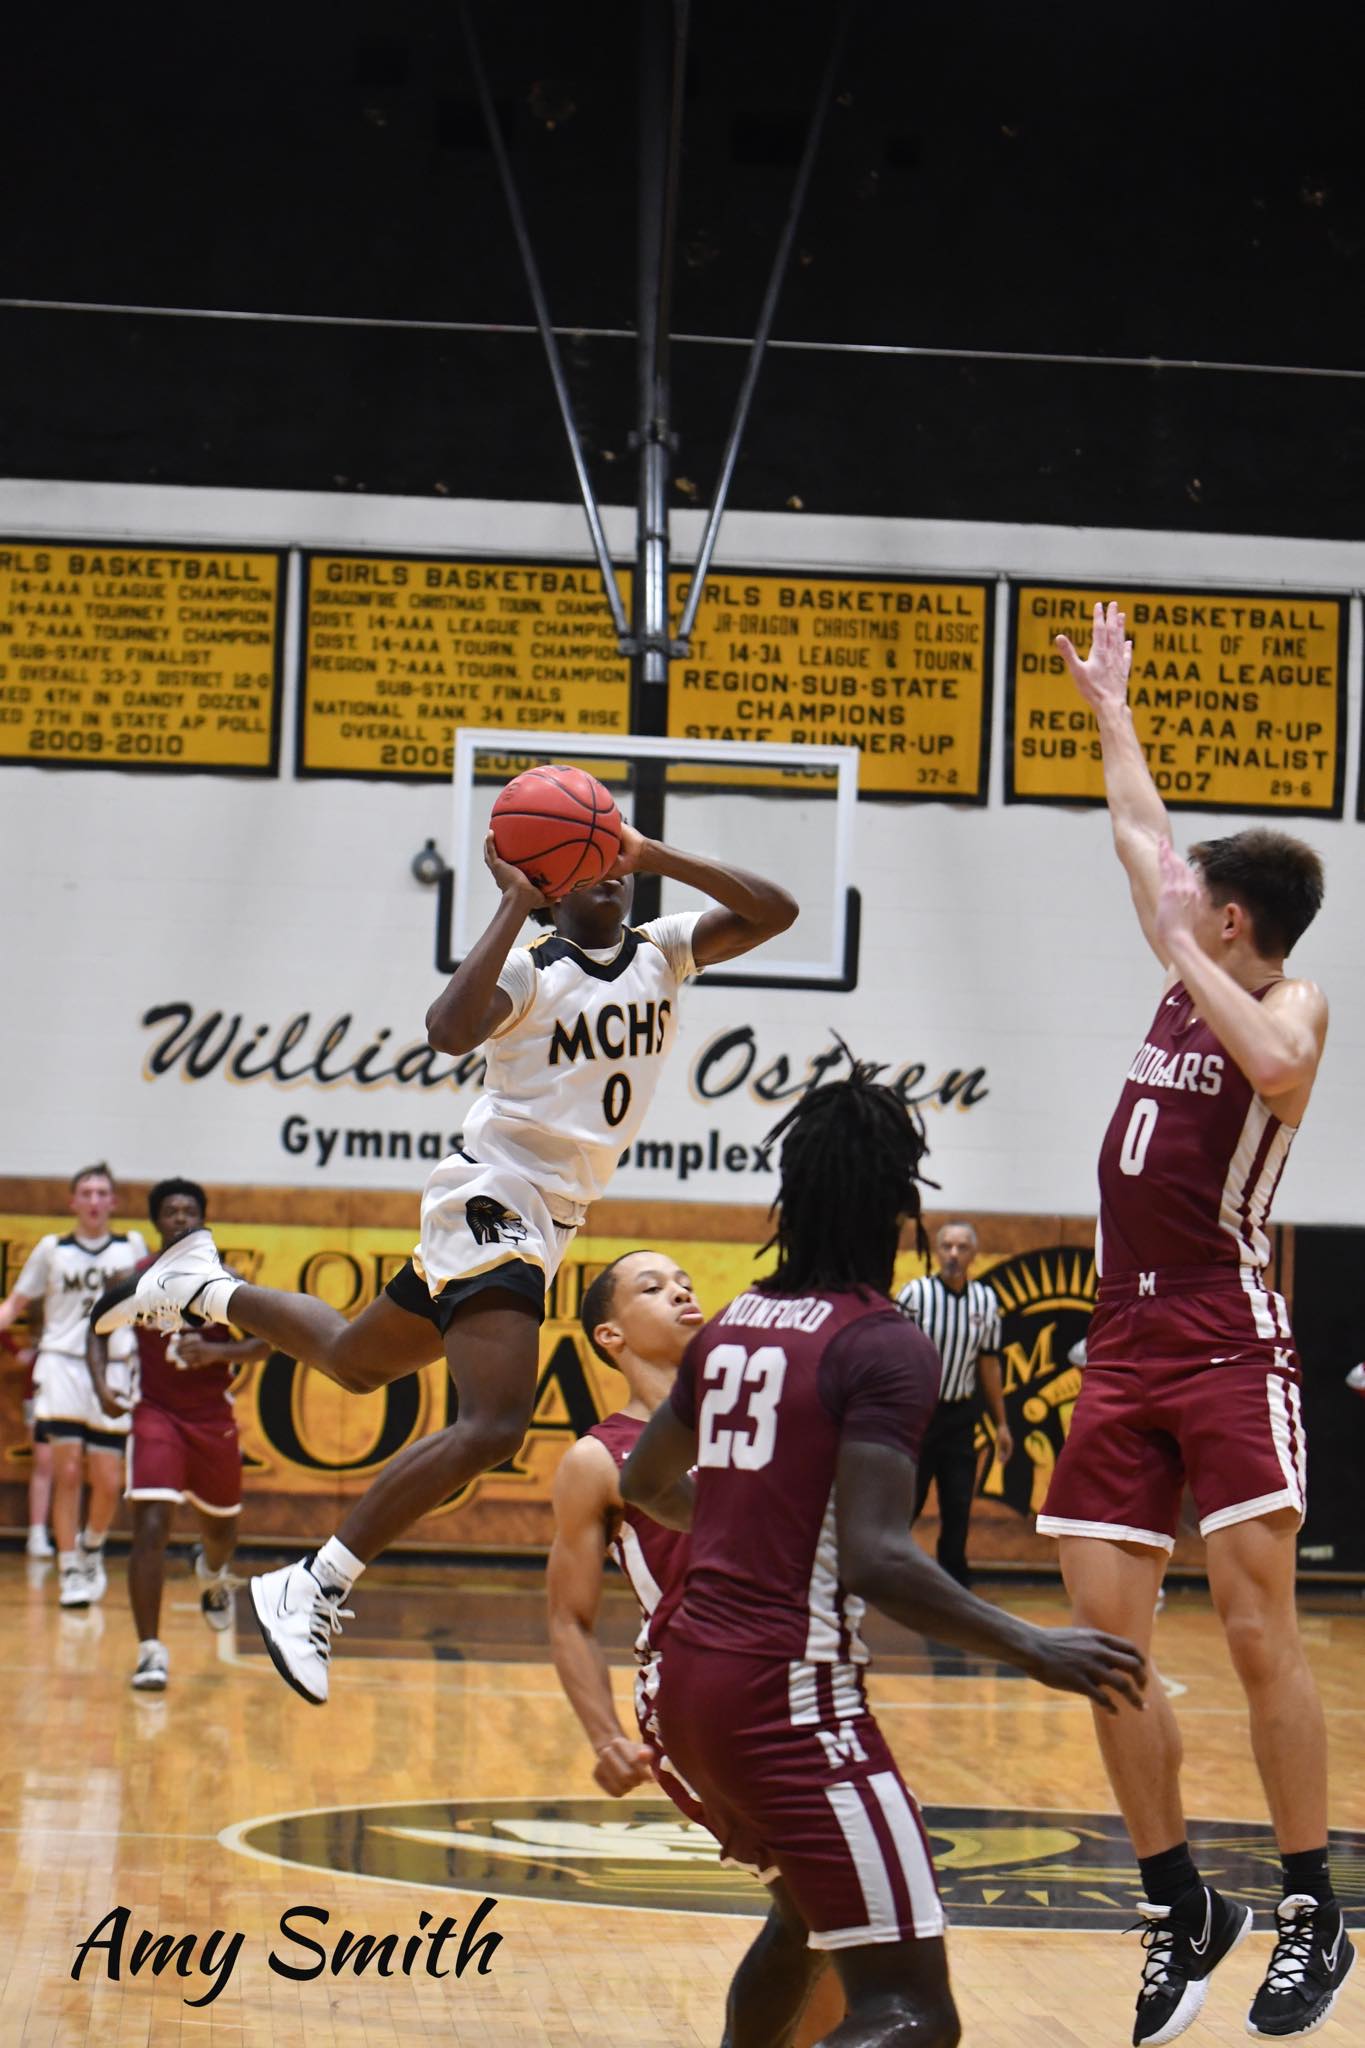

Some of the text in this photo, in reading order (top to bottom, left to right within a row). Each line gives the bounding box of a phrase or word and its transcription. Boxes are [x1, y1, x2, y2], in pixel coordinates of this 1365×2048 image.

[68, 555, 260, 581] BASKETBALL
[327, 563, 408, 585] GIRLS
[93, 581, 165, 599] LEAGUE
[178, 585, 272, 602] CHAMPION
[676, 583, 972, 616] GRLS BASKETBALL
[85, 603, 164, 621] TOURNEY
[178, 606, 269, 624] CHAMPION
[368, 613, 434, 632] 14-AAA
[447, 617, 519, 636] LEAGUE
[533, 620, 616, 639] CHAMPIO
[1031, 597, 1325, 630] GIRL BASKETBALL
[94, 624, 169, 642] TOURNEY
[183, 628, 271, 646] CHAMPION
[813, 617, 900, 641] CHRISTMAS
[915, 621, 979, 645] CLASSIC
[125, 647, 211, 665] FINALIST
[372, 636, 440, 653] 14-AAA
[729, 642, 782, 664] 14-3A
[798, 645, 870, 668] LEAGUE
[1153, 631, 1201, 655] HALL
[1221, 637, 1243, 656] OF
[1262, 638, 1307, 659] FAME
[311, 655, 377, 673] REGION
[387, 658, 446, 676] 7-AAA
[532, 664, 626, 683] CHAMPION
[1022, 653, 1065, 675] DIS
[1219, 664, 1333, 687] LEAGUE
[376, 680, 561, 703] SUB-STATE FINALS
[111, 711, 168, 730] STATE
[180, 714, 206, 731] AP
[217, 715, 266, 734] POLL
[313, 700, 404, 718] NATIONAL
[417, 703, 466, 720] RANK
[517, 707, 566, 724] ESPN
[578, 709, 620, 727] RISE
[736, 700, 905, 725] CHAMPIONS
[340, 722, 427, 741] OVERALL
[1150, 716, 1237, 740] 7-AAA
[1256, 720, 1323, 742] R-UP
[29, 730, 184, 756] 2009-2010
[1195, 744, 1329, 771] FINALIST
[917, 768, 957, 784] 37-2
[548, 998, 672, 1066] MCHS
[602, 1072, 632, 1127] 0
[1119, 1098, 1159, 1176] 0
[1138, 1271, 1157, 1297] M
[1002, 1321, 1058, 1395] M
[697, 1343, 788, 1472] 23
[815, 1720, 869, 1770] M
